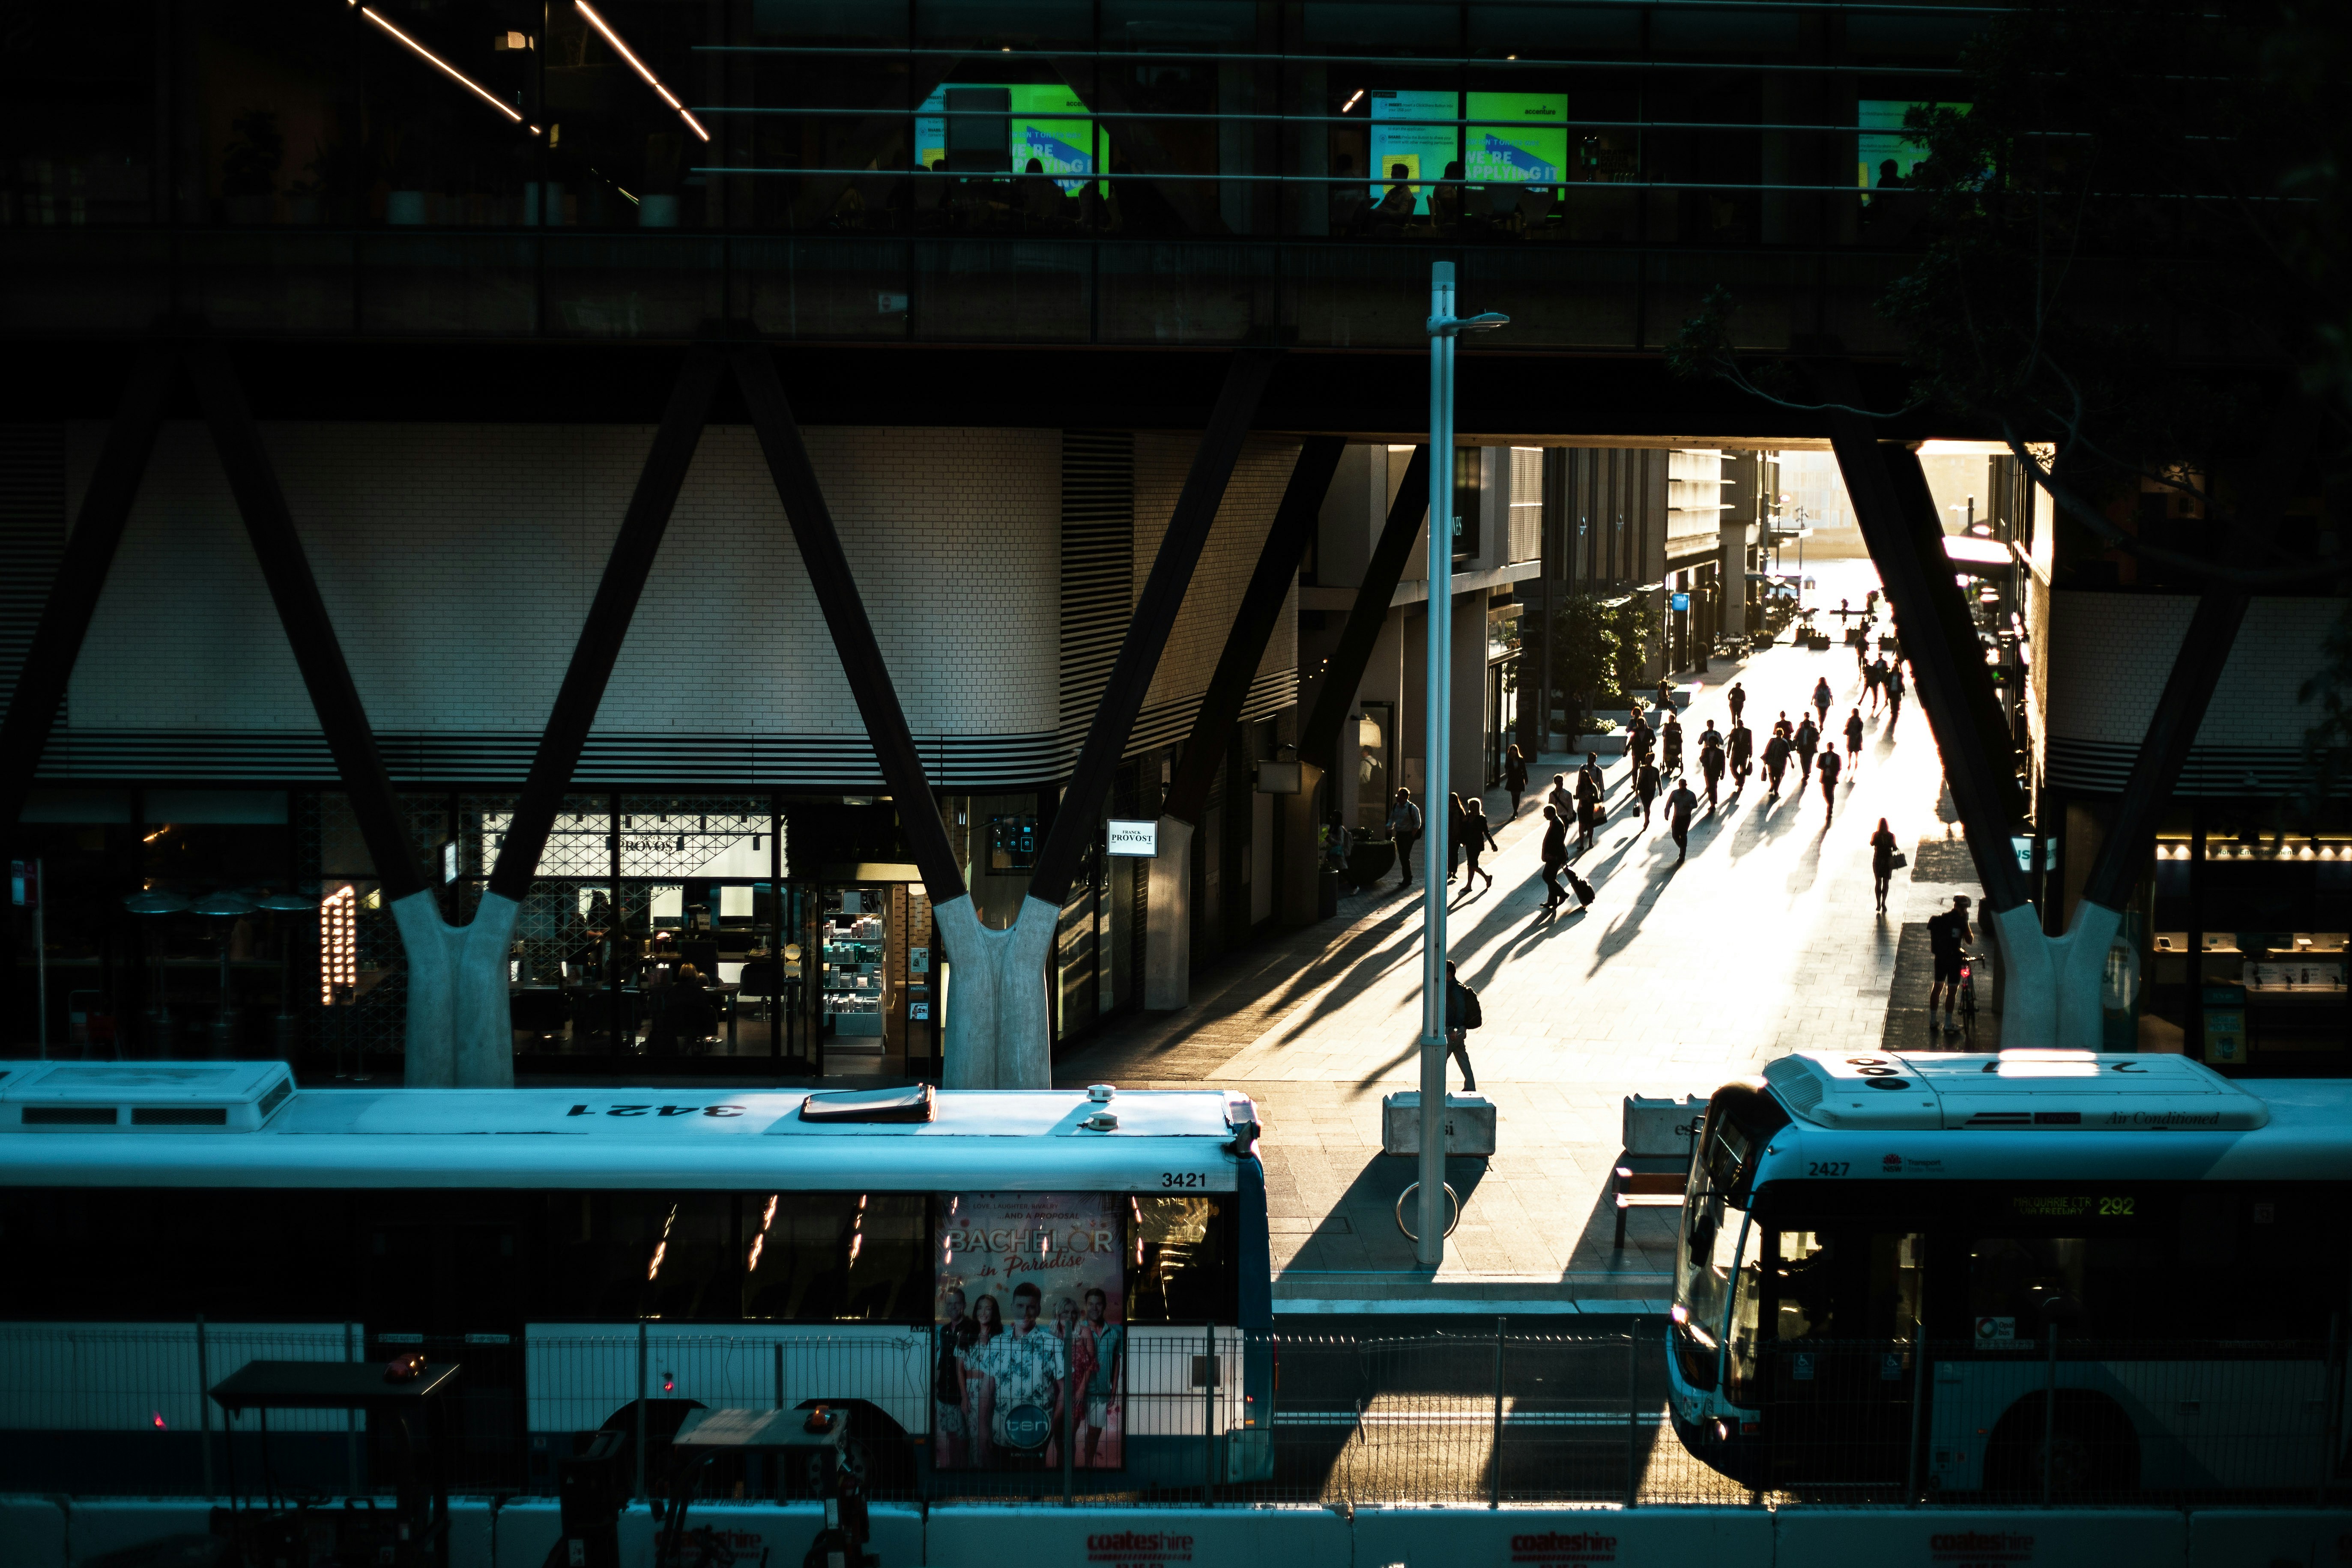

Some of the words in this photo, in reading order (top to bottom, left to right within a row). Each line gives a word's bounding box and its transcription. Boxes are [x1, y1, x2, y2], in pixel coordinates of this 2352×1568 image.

[1465, 165, 1541, 180] APPLYING
[1545, 166, 1560, 180] IT
[566, 1105, 747, 1117] 3421
[2106, 1111, 2132, 1124] Air
[2134, 1111, 2219, 1125] Conditioned
[1809, 1162, 1850, 1176] 2427
[1162, 1173, 1205, 1187] 3421
[2013, 1197, 2069, 1207] MACQUARIE
[2073, 1197, 2092, 1207] CTR
[2099, 1197, 2135, 1215] 292
[947, 1228, 1114, 1253] BACHELOR
[977, 1265, 998, 1277] in
[1003, 1248, 1085, 1278] Paradise
[1999, 1321, 2015, 1329] Opal
[1007, 1420, 1048, 1431] ten
[1087, 1530, 1193, 1550] coateshire
[1512, 1531, 1617, 1551] coateshire
[1931, 1530, 2034, 1550] coateshire
